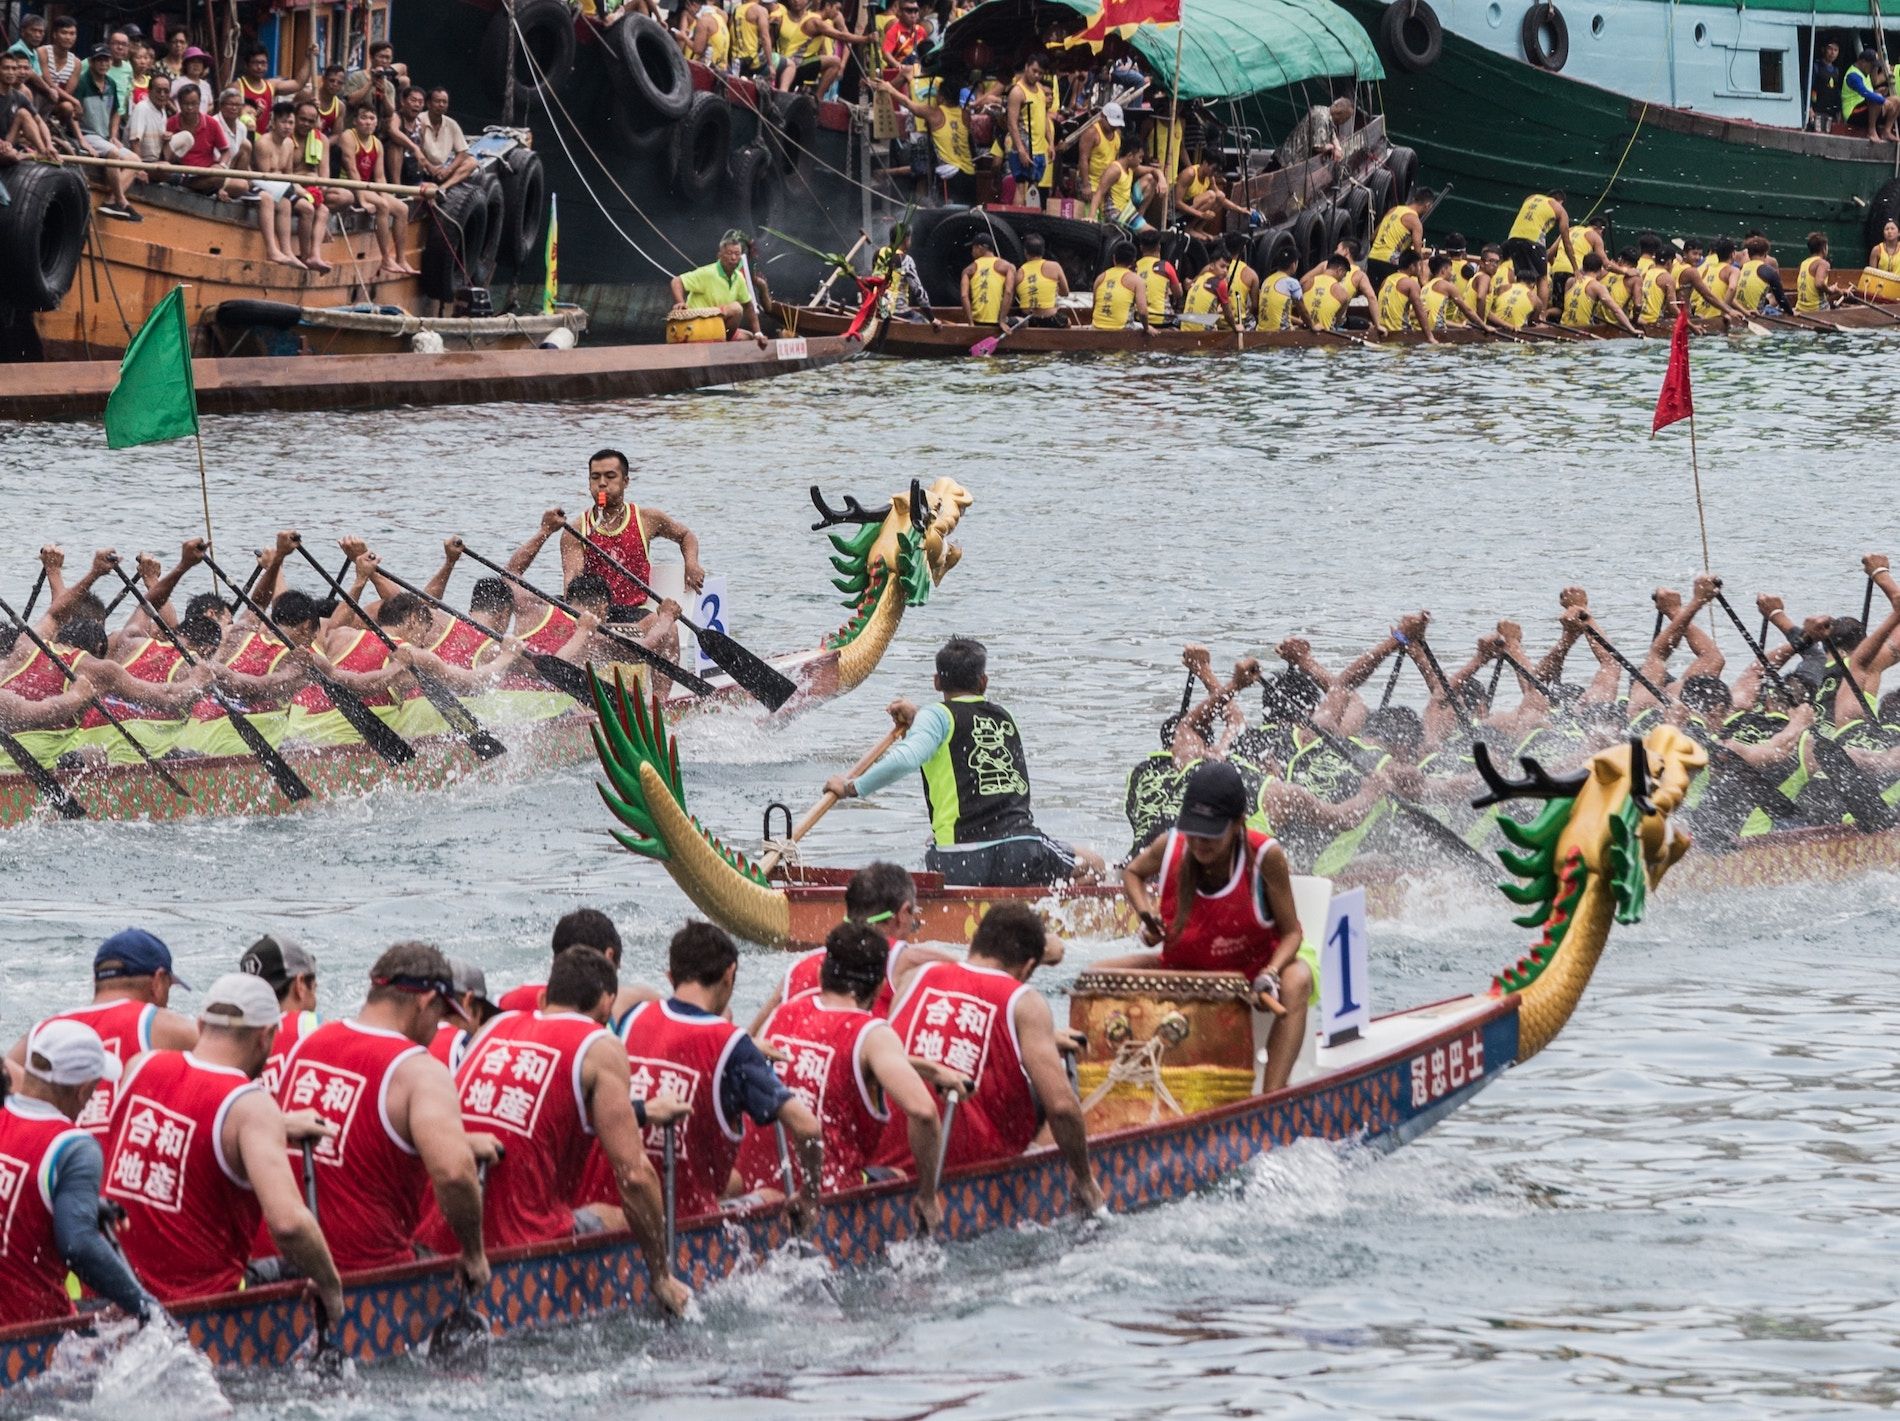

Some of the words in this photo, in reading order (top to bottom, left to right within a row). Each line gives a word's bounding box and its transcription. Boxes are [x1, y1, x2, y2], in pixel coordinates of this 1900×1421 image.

[701, 594, 725, 660] 3
[1329, 914, 1361, 1019] 1
[926, 997, 987, 1037] 合和
[481, 1047, 549, 1084] 合和
[773, 1043, 826, 1087] 合和
[913, 1028, 981, 1076] 地產
[1411, 1030, 1484, 1109] 冠忠巴士
[293, 1068, 356, 1113] 合和
[464, 1078, 535, 1126] 地產
[630, 1065, 690, 1102] 合和
[76, 1089, 111, 1128] 產
[129, 1107, 186, 1159] 合和
[114, 1149, 178, 1203] 地產
